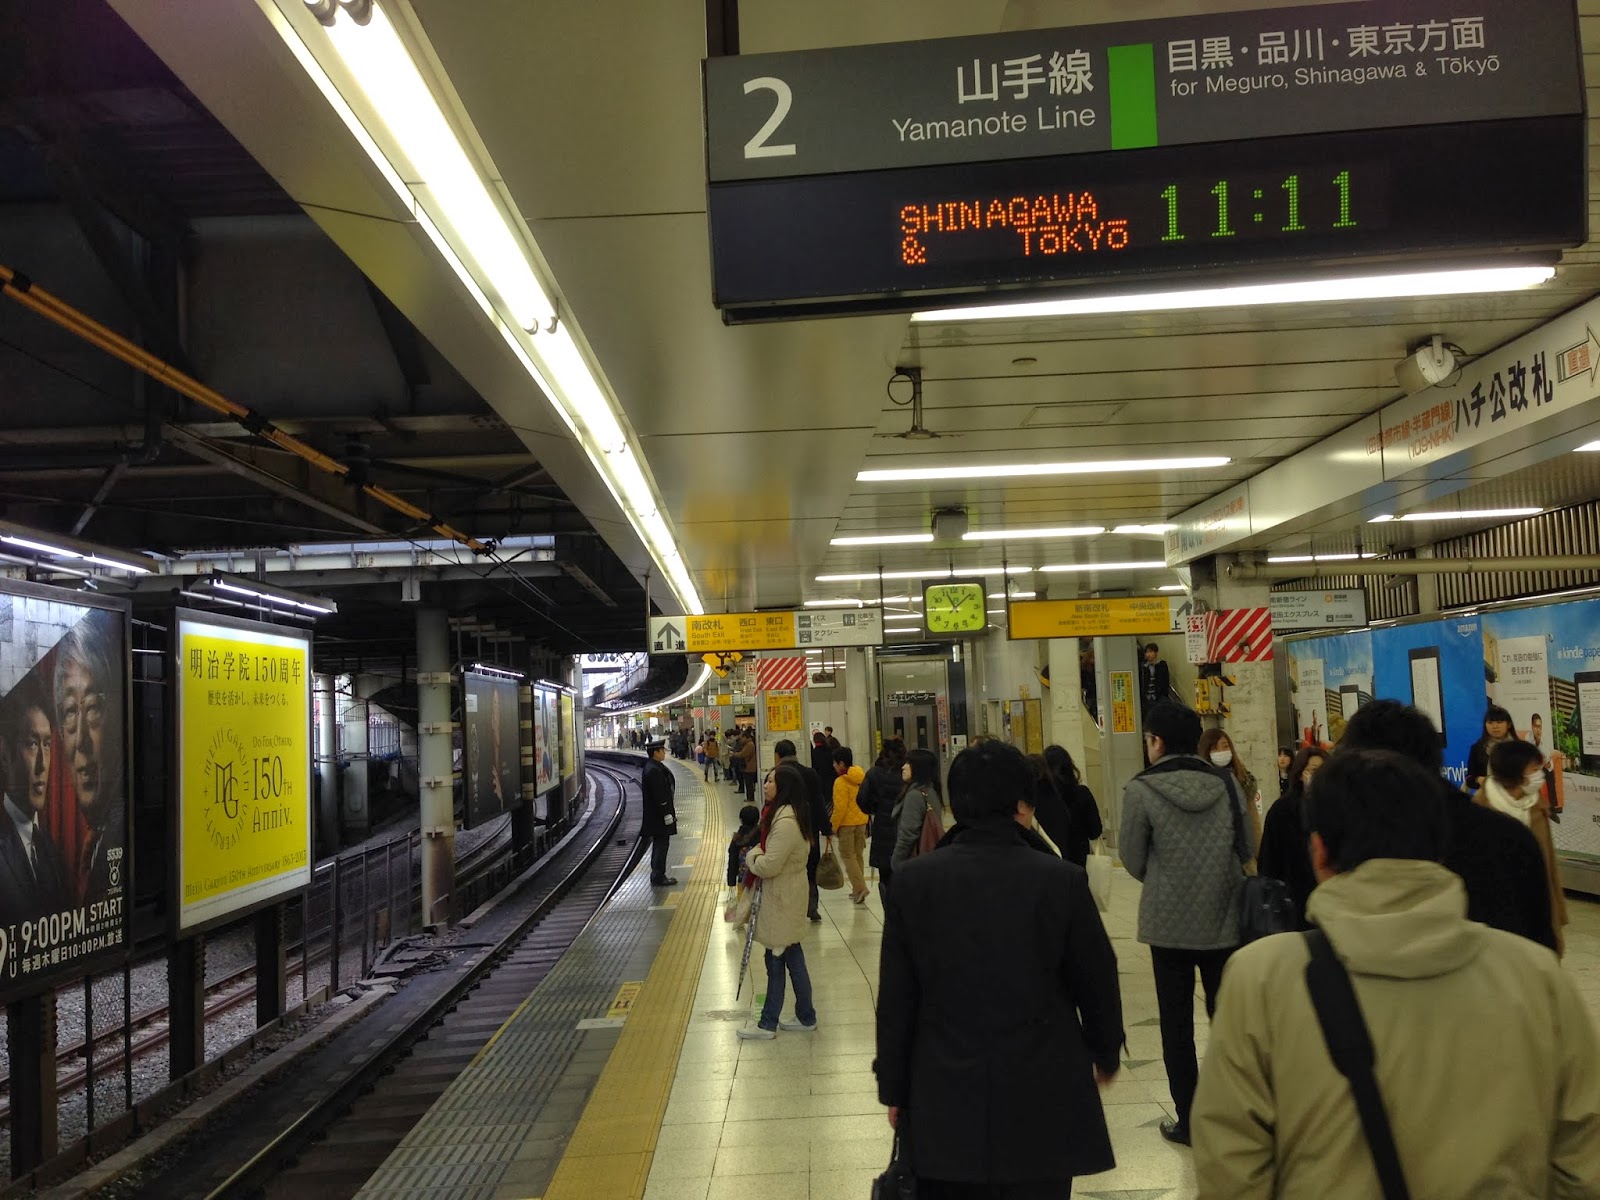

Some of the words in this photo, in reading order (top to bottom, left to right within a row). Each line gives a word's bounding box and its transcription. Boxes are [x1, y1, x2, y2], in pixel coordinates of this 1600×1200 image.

[1167, 16, 1486, 74] 目黒・品川・東京方面
[957, 49, 1094, 104] 山手線
[1171, 78, 1198, 97] for
[1206, 73, 1289, 95] Meguro,
[1295, 65, 1407, 86] Shinagawa
[1415, 61, 1427, 76] &
[743, 77, 796, 159] 2
[892, 110, 1027, 142] Yamanote
[1037, 105, 1096, 131] Line
[901, 191, 1098, 235] SHINAGAWA
[1160, 170, 1357, 241] 11:11
[902, 236, 926, 264] &
[1568, 344, 1590, 375] 直進
[1455, 351, 1553, 433] ハチ公改札
[691, 619, 724, 631] 南改札
[739, 618, 756, 627] 西口
[1171, 620, 1181, 630] 上
[1457, 623, 1478, 634] amazon
[654, 641, 664, 651] 直
[675, 640, 686, 651] 進
[1562, 645, 1583, 659] kindle
[190, 648, 301, 684] 明治学院150周年
[899, 694, 936, 702] エレベーター
[90, 897, 123, 922] START
[21, 907, 90, 954] 9:00P.M.
[9, 925, 17, 978] THU
